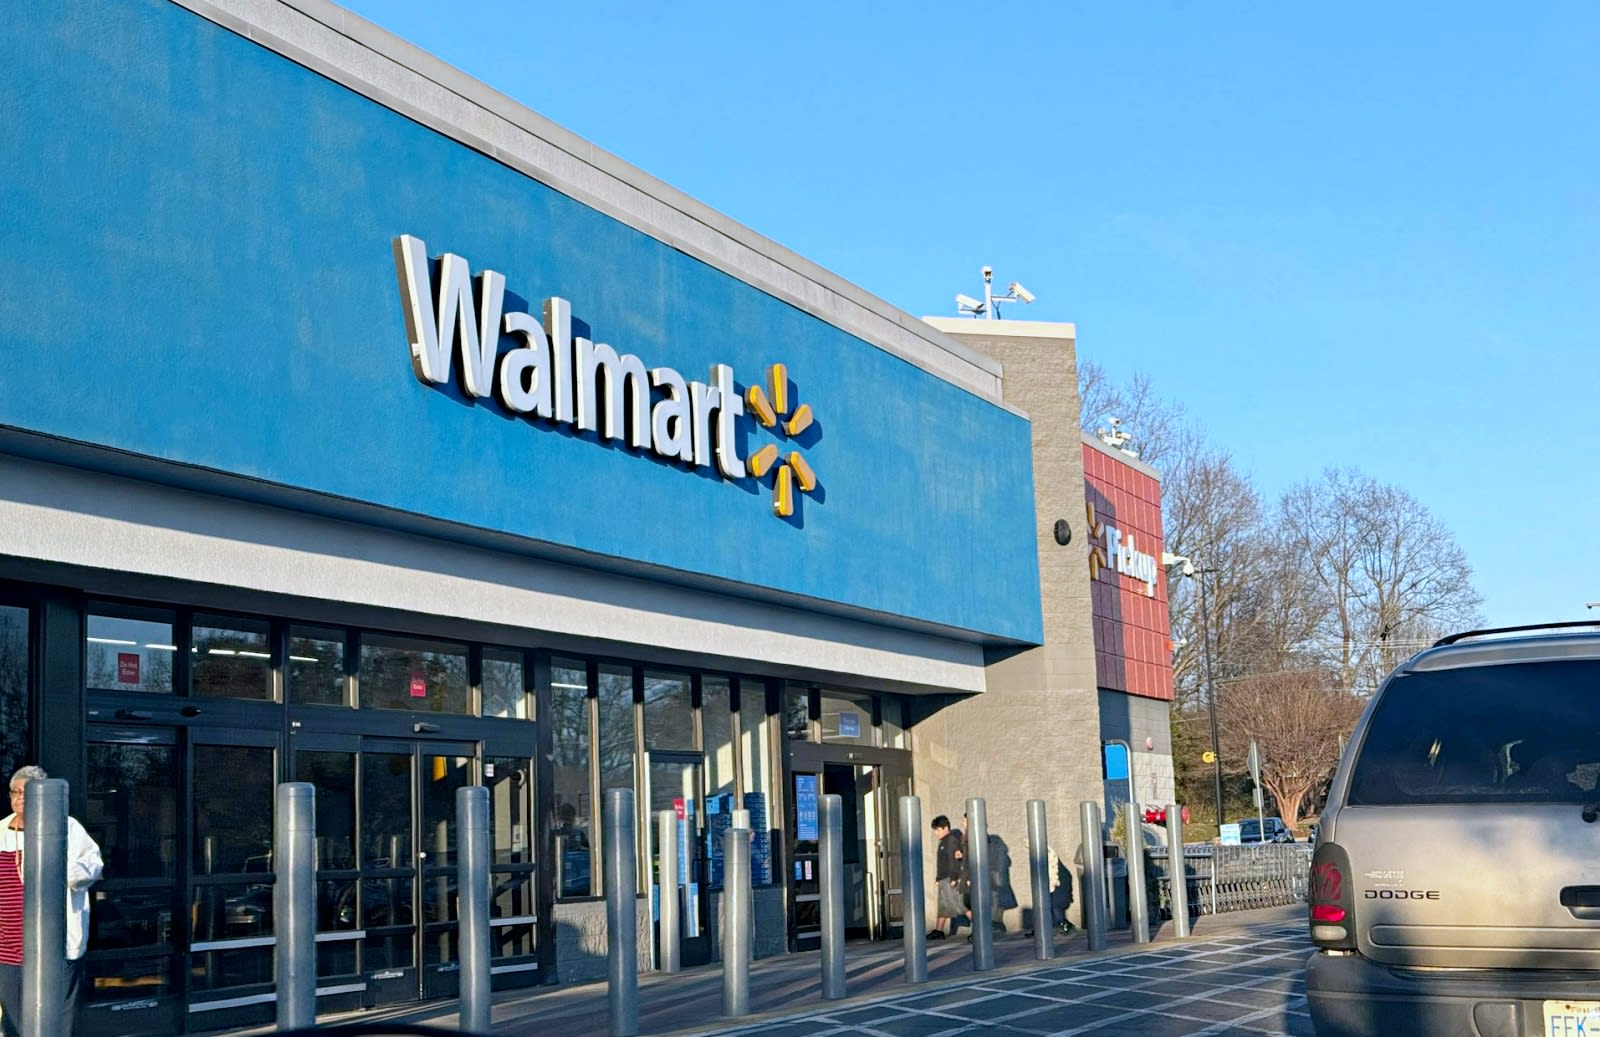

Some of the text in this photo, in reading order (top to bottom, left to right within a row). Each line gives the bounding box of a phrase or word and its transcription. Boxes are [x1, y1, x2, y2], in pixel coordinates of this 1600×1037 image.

[394, 234, 746, 479] Walmart
[1106, 525, 1157, 597] Pickup
[1364, 889, 1440, 900] DODGE
